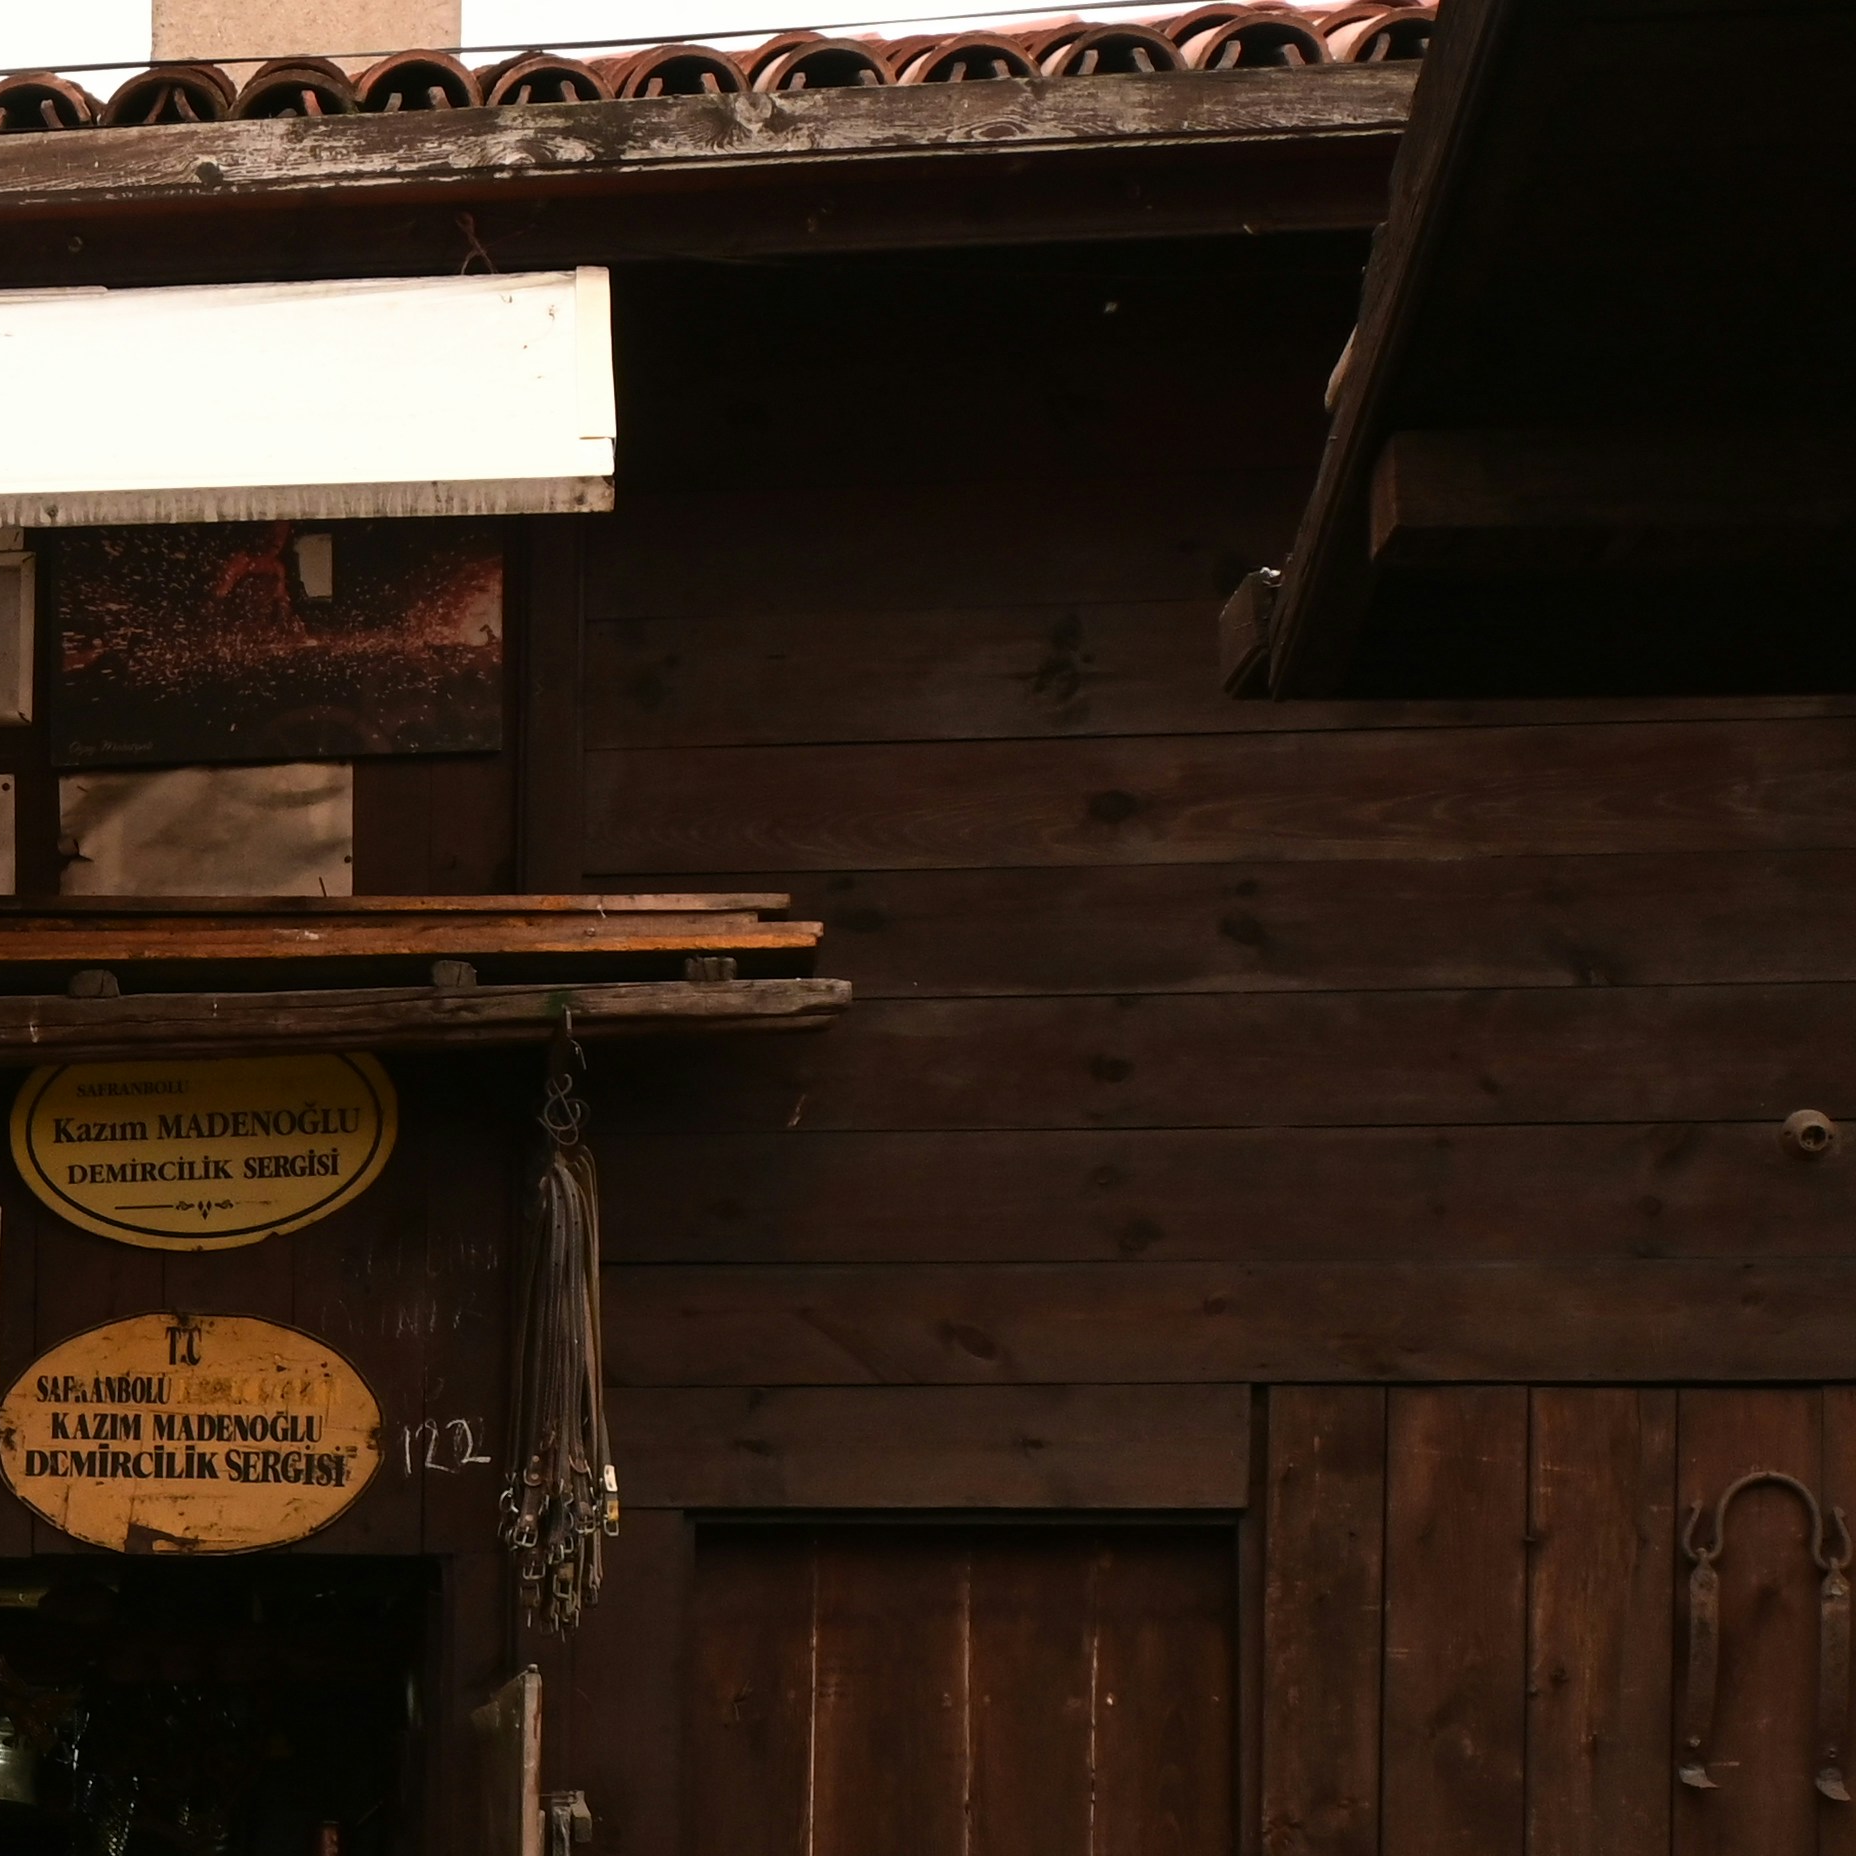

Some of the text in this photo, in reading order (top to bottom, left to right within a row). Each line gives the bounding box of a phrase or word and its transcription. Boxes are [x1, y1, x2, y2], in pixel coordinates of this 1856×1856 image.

[75, 1080, 187, 1098] SAFRANBOLU
[52, 1101, 361, 1144] Kazım MADENOĞLU
[67, 1147, 341, 1185] DEMİRCİLİK SERGİSİ
[50, 1411, 323, 1442] KAZIM MADENOĞLU
[24, 1443, 347, 1487] DEMİRCİLİK SERGİSİ
